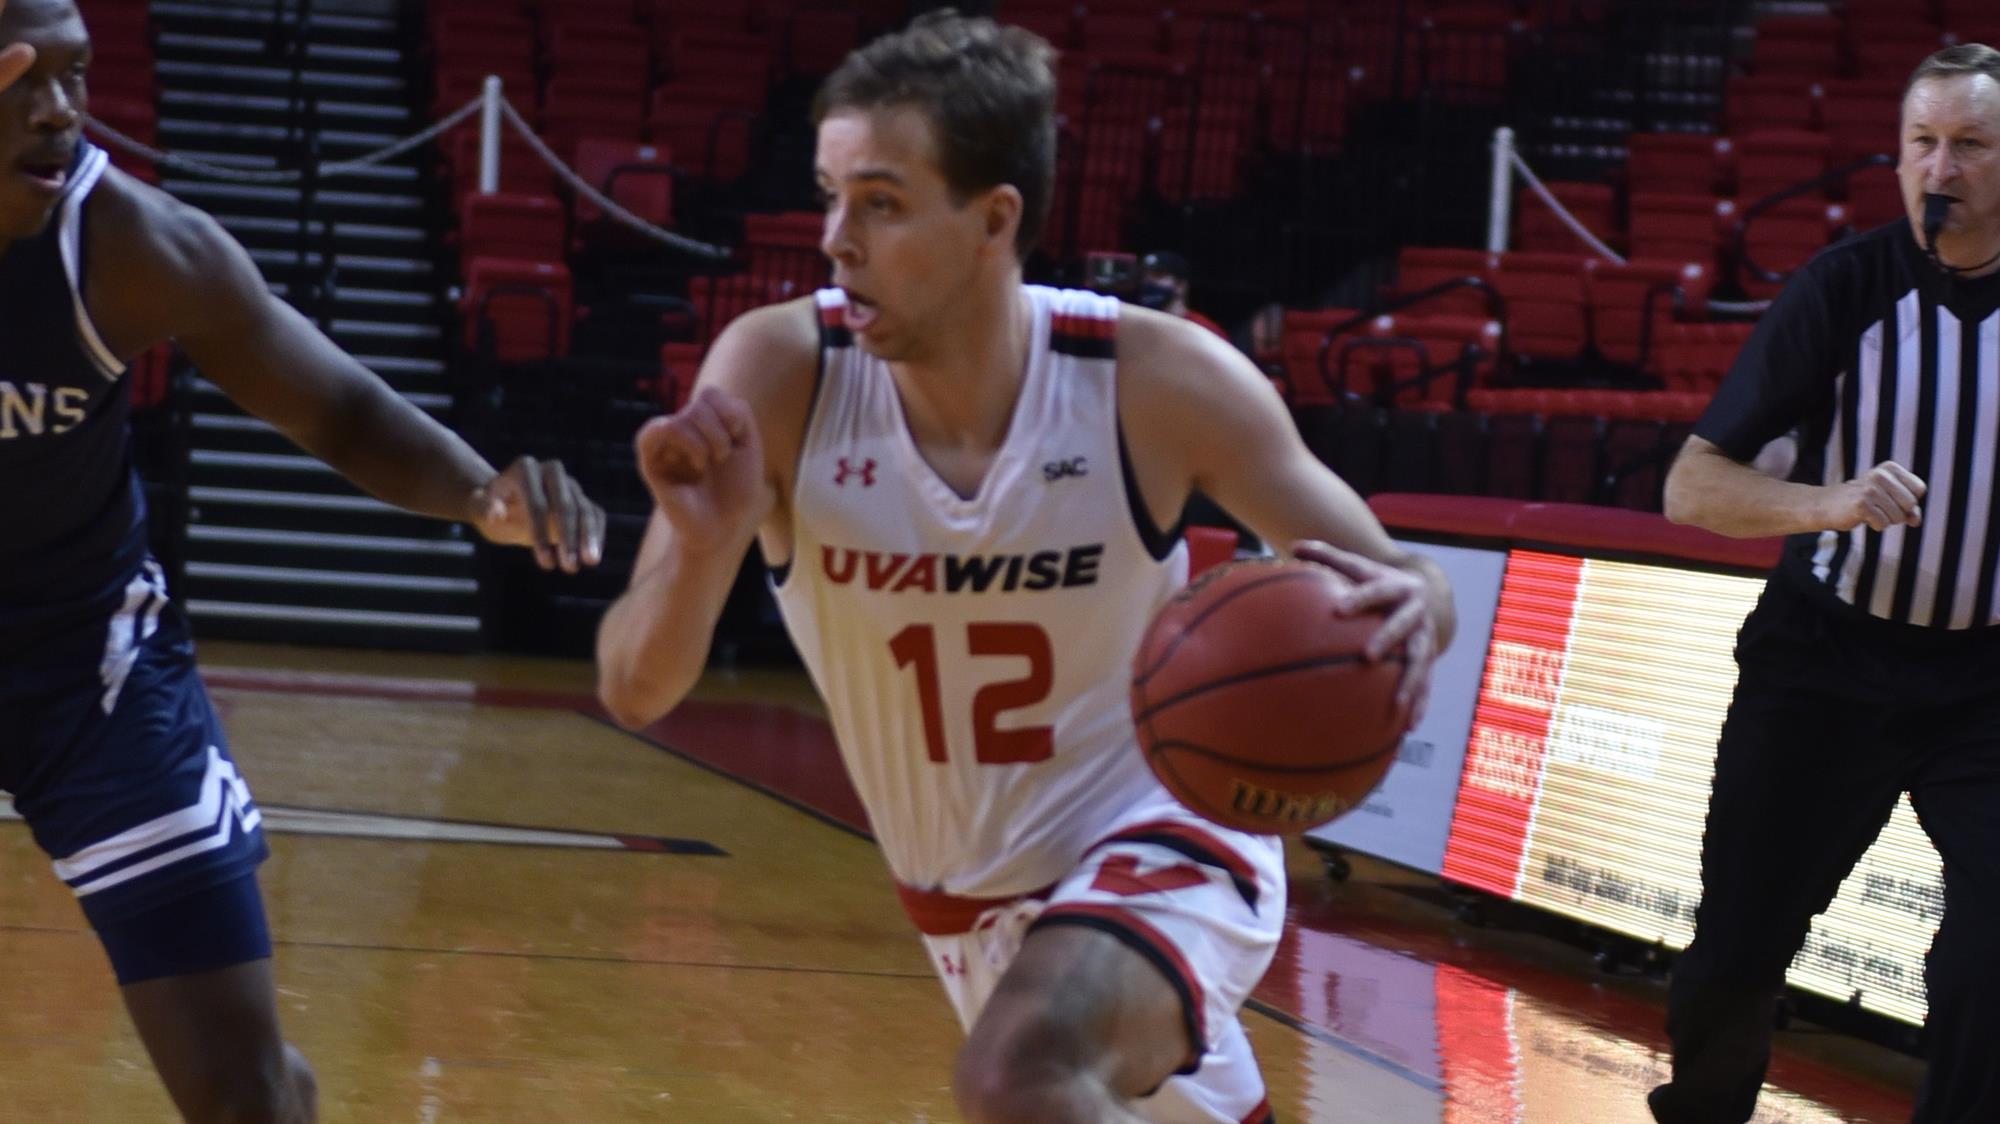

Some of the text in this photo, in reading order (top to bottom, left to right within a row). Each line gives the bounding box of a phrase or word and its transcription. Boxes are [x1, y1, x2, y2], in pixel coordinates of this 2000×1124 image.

[1043, 456, 1089, 482] SAC
[820, 543, 1105, 593] UVAWISE
[888, 622, 1055, 765] 12
